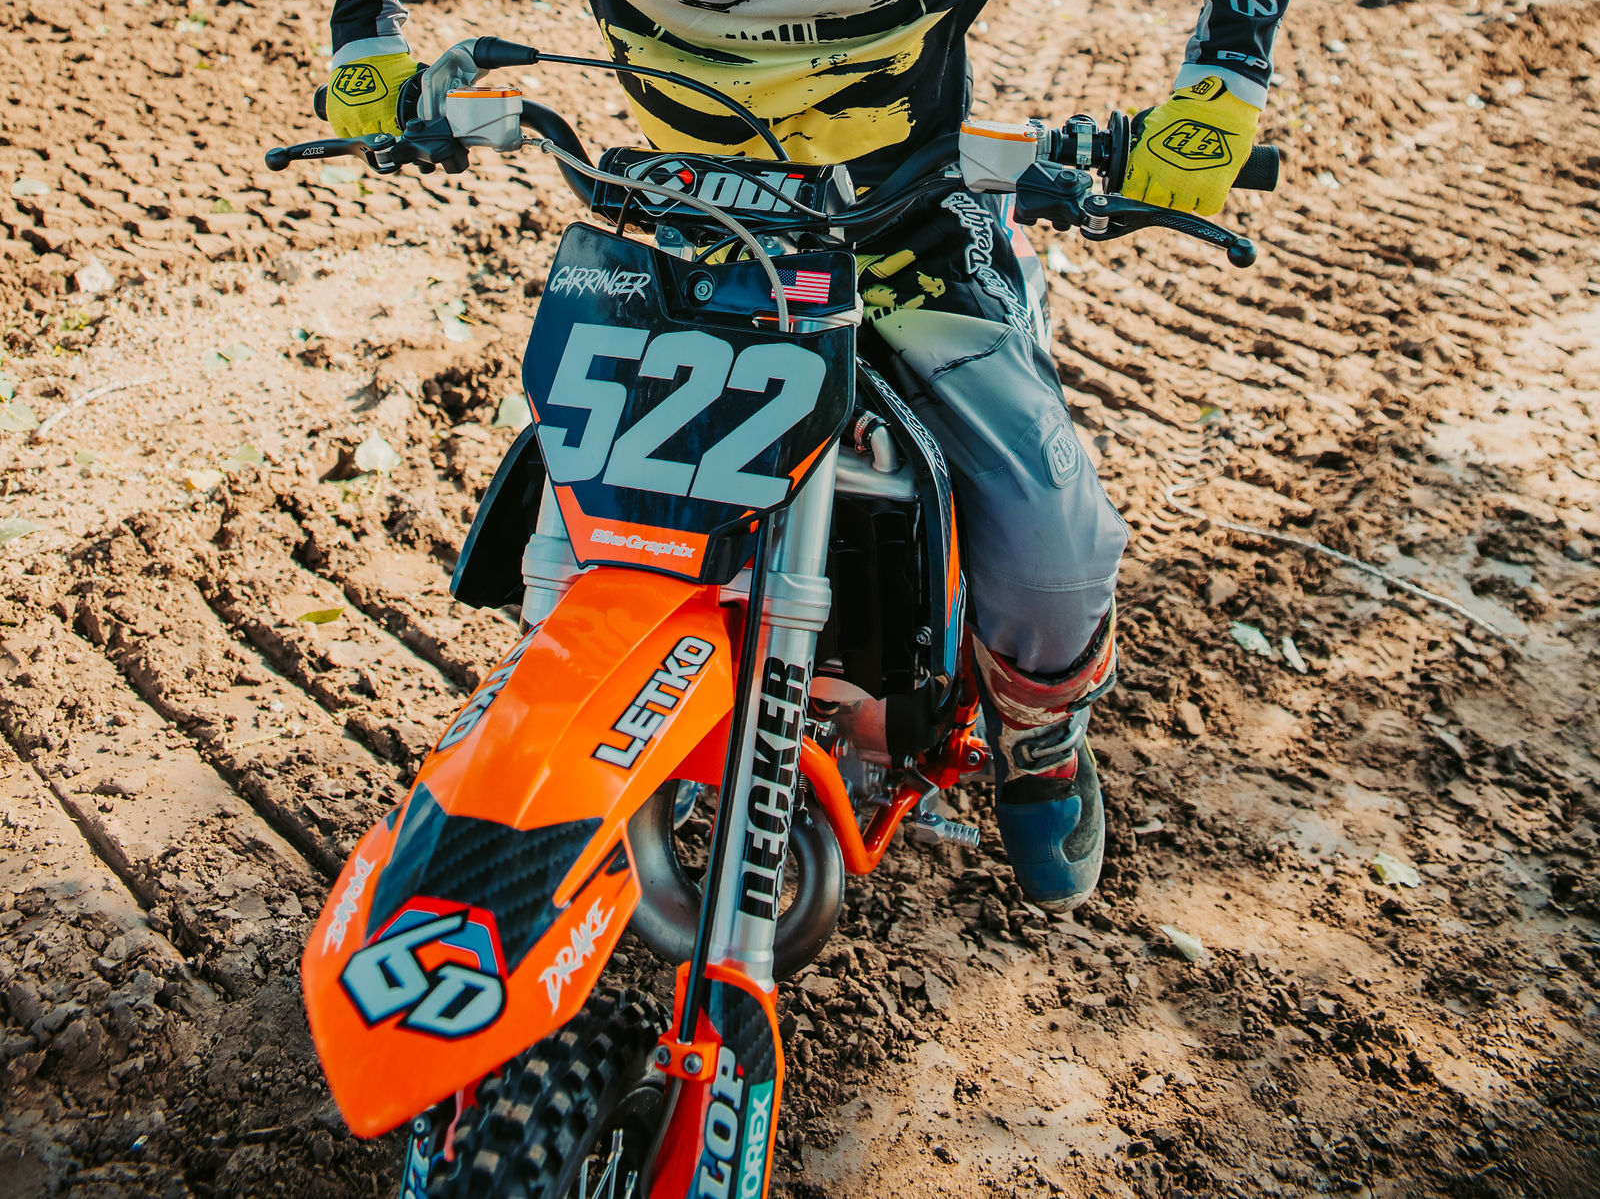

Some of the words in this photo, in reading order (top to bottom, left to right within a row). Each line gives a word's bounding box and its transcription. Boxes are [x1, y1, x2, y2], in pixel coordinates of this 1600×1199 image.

[301, 146, 325, 157] ARC
[549, 264, 652, 304] GARRINGER
[538, 322, 827, 509] 522
[591, 635, 716, 771] LETKO
[738, 656, 810, 920] DECKER
[339, 909, 507, 1041] 6D
[538, 897, 616, 1017] DRAKE
